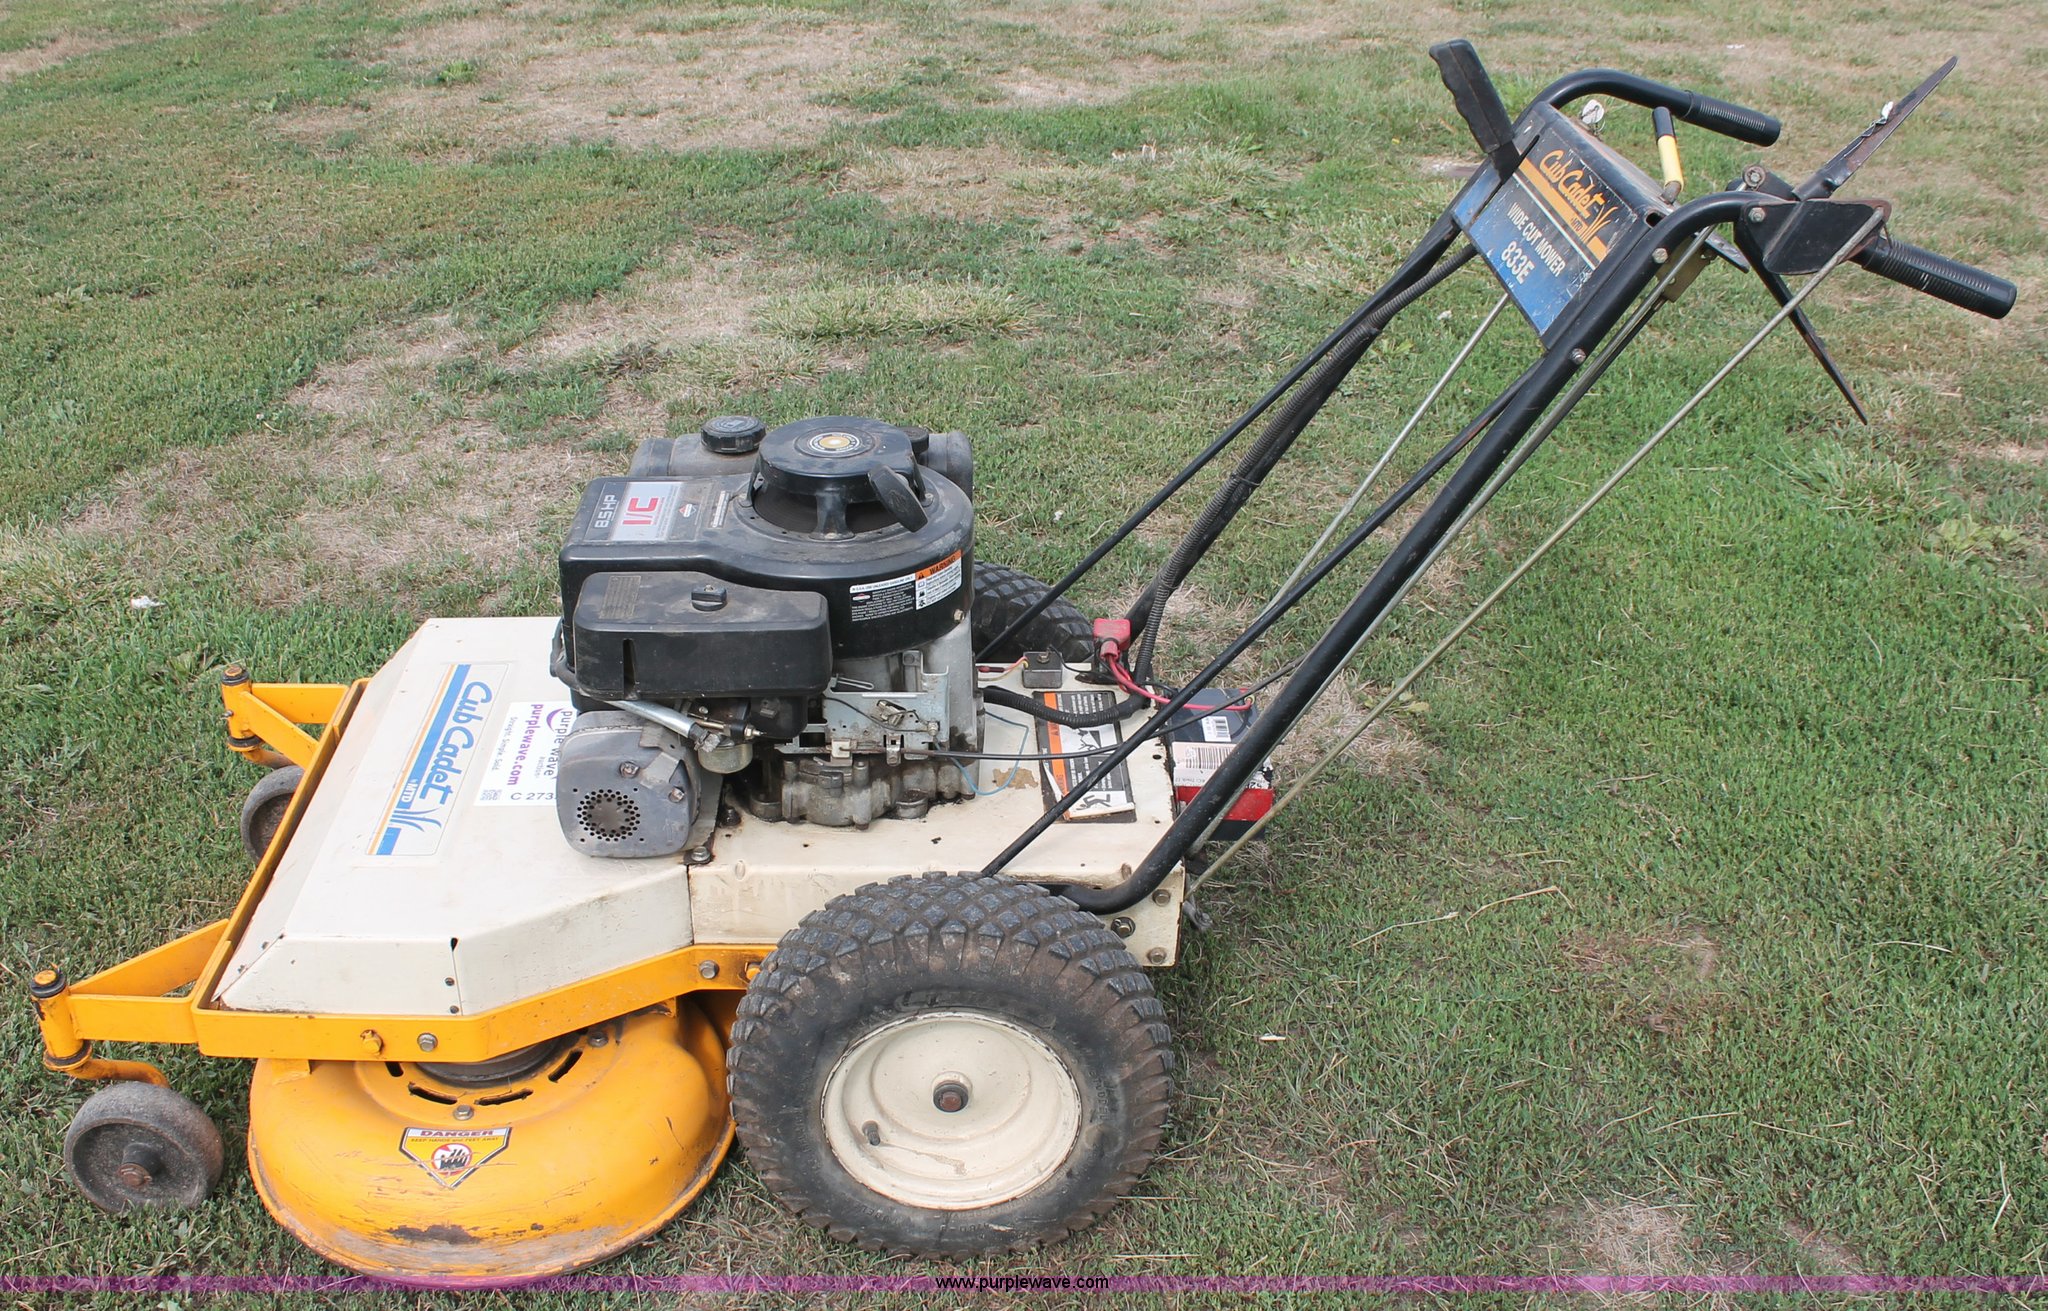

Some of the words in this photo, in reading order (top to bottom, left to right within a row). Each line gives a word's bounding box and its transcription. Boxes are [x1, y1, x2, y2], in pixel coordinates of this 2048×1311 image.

[1539, 150, 1572, 184] Cub
[1558, 169, 1606, 219] Cadet
[1506, 201, 1524, 231] WIDE
[1522, 219, 1543, 247] CUT
[1534, 236, 1568, 277] MOWER
[1501, 241, 1535, 285] 833E
[930, 555, 957, 576] WARNING
[451, 681, 493, 723] Cub
[507, 704, 544, 786] purplewave.com
[553, 711, 573, 745] purple
[419, 726, 474, 805] Cadet
[543, 746, 563, 776] wave
[510, 792, 522, 801] C
[526, 792, 557, 801] 273
